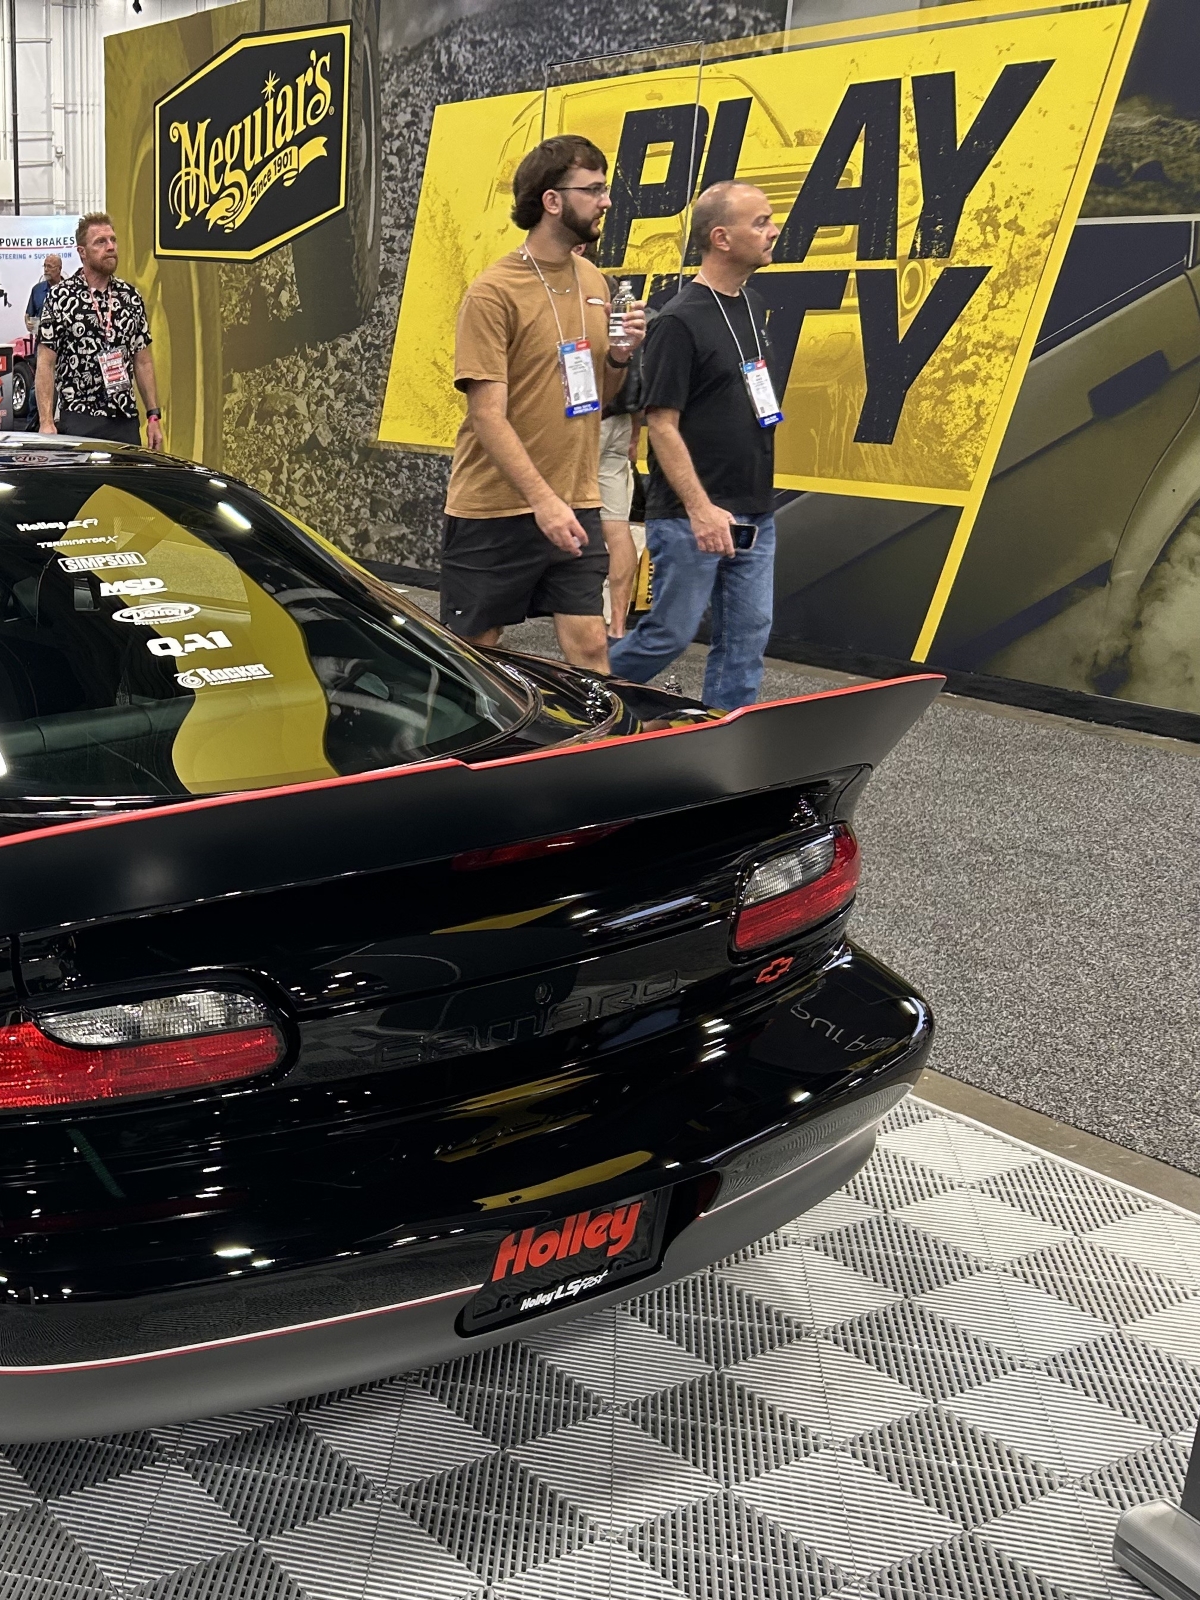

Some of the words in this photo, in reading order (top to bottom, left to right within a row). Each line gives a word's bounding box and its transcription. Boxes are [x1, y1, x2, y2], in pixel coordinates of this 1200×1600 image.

[169, 50, 332, 231] Meguiar's
[250, 173, 273, 205] Since
[273, 151, 293, 177] 1901
[0, 236, 34, 247] POWER
[35, 235, 76, 247] BRAKES
[65, 554, 139, 571] SIMPSON
[100, 577, 165, 596] MSD
[146, 630, 233, 657] QA1
[196, 663, 271, 683] ROCKET
[491, 1202, 643, 1282] Holley
[520, 1293, 555, 1311] Holley
